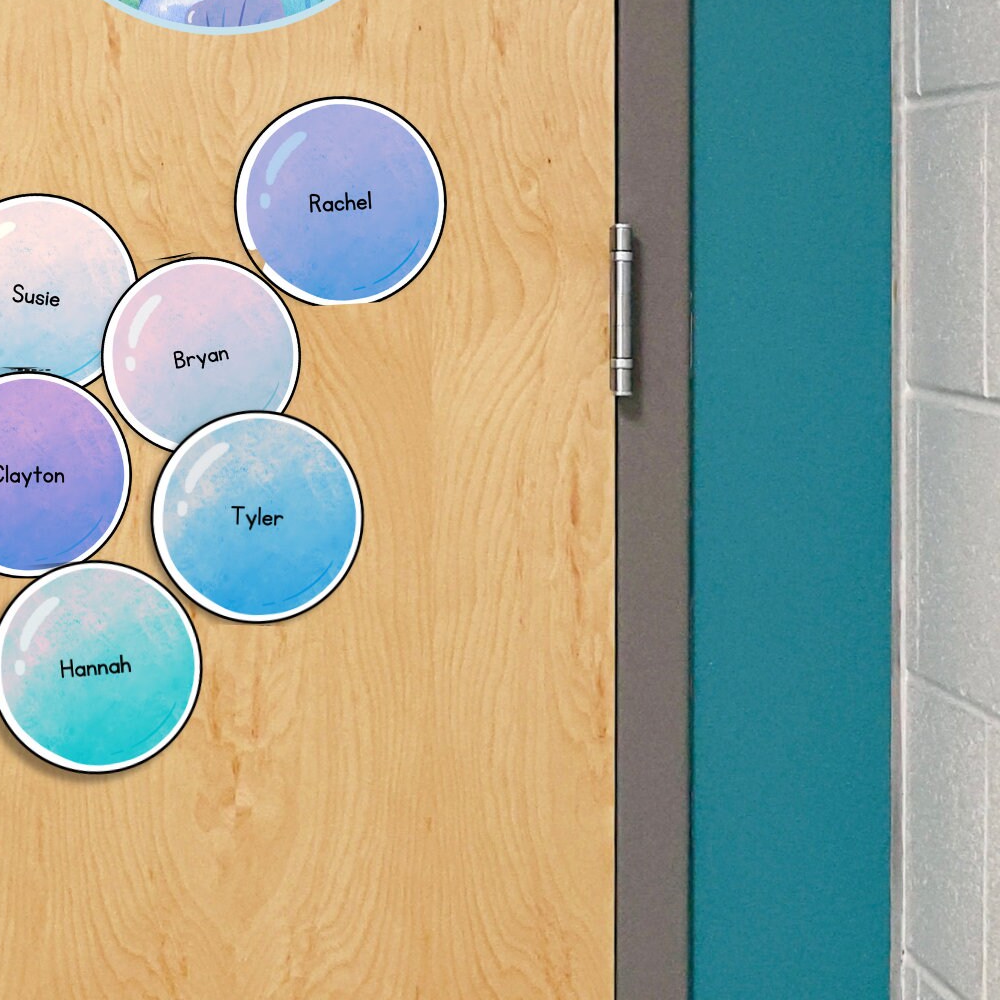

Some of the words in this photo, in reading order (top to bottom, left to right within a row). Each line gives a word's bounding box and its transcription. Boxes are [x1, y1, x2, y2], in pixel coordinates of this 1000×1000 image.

[309, 190, 372, 214] Rachel
[12, 283, 61, 307] Susie
[173, 349, 230, 370] Bryan
[230, 505, 284, 531] Tyler
[59, 654, 132, 679] Hannah
